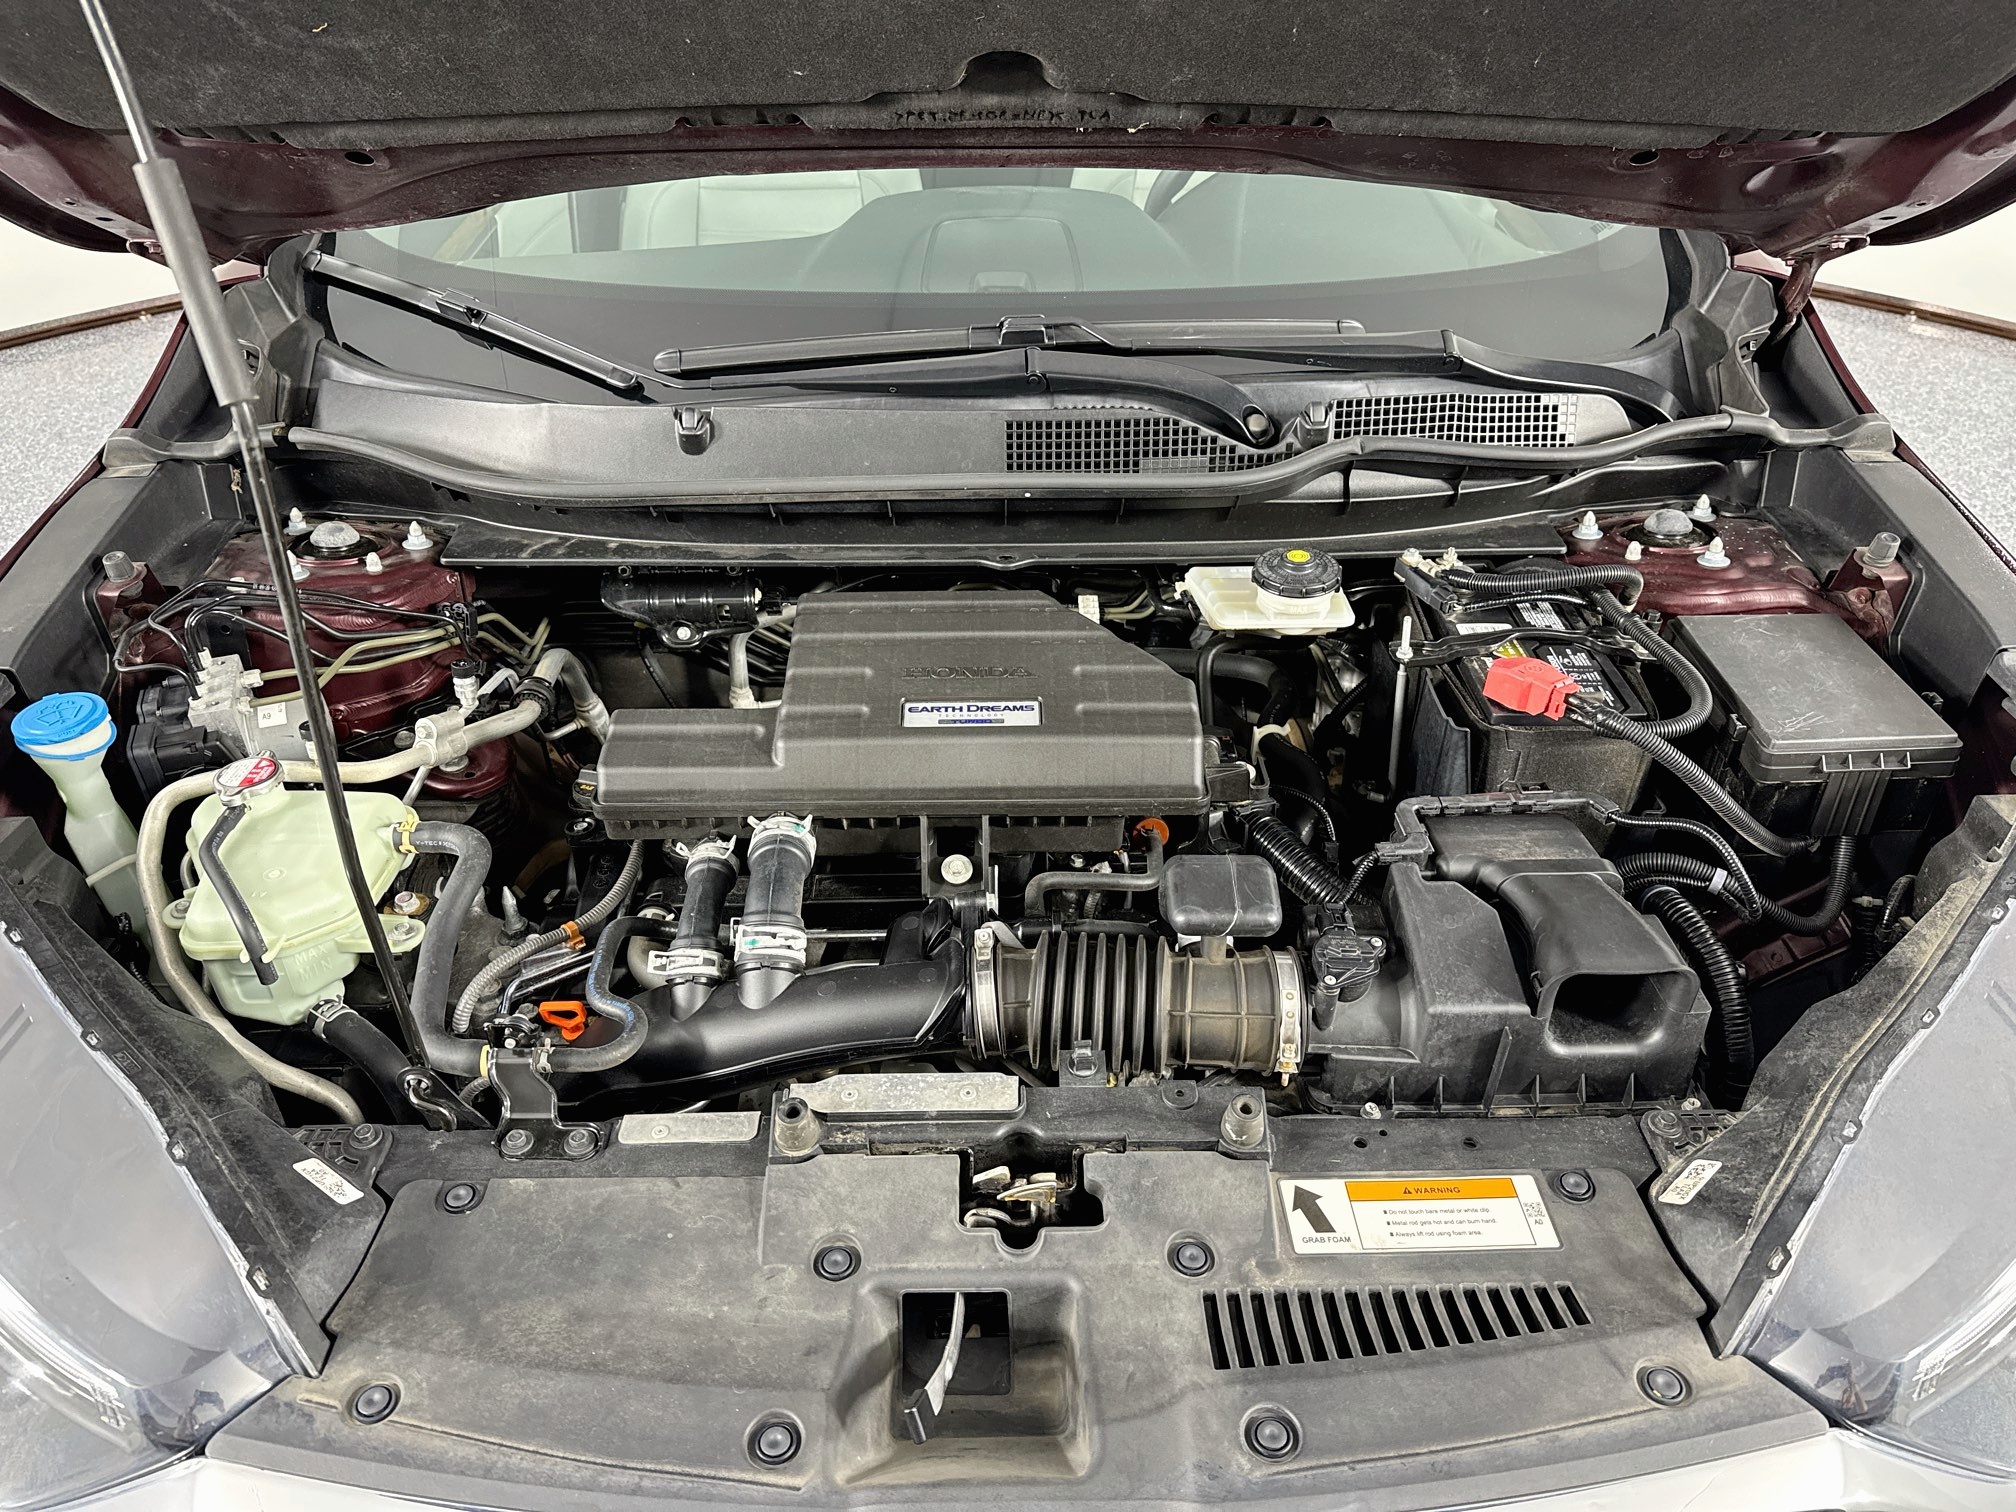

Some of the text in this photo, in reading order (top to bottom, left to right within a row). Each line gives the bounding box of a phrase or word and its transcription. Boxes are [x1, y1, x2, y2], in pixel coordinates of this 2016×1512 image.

[901, 666, 1037, 680] HONDA
[907, 704, 1035, 713] EARTH DREAMS
[294, 944, 328, 966] MAX
[298, 957, 333, 982] MIN
[1413, 1186, 1461, 1194] WARNING
[1301, 1236, 1326, 1244] GRAB
